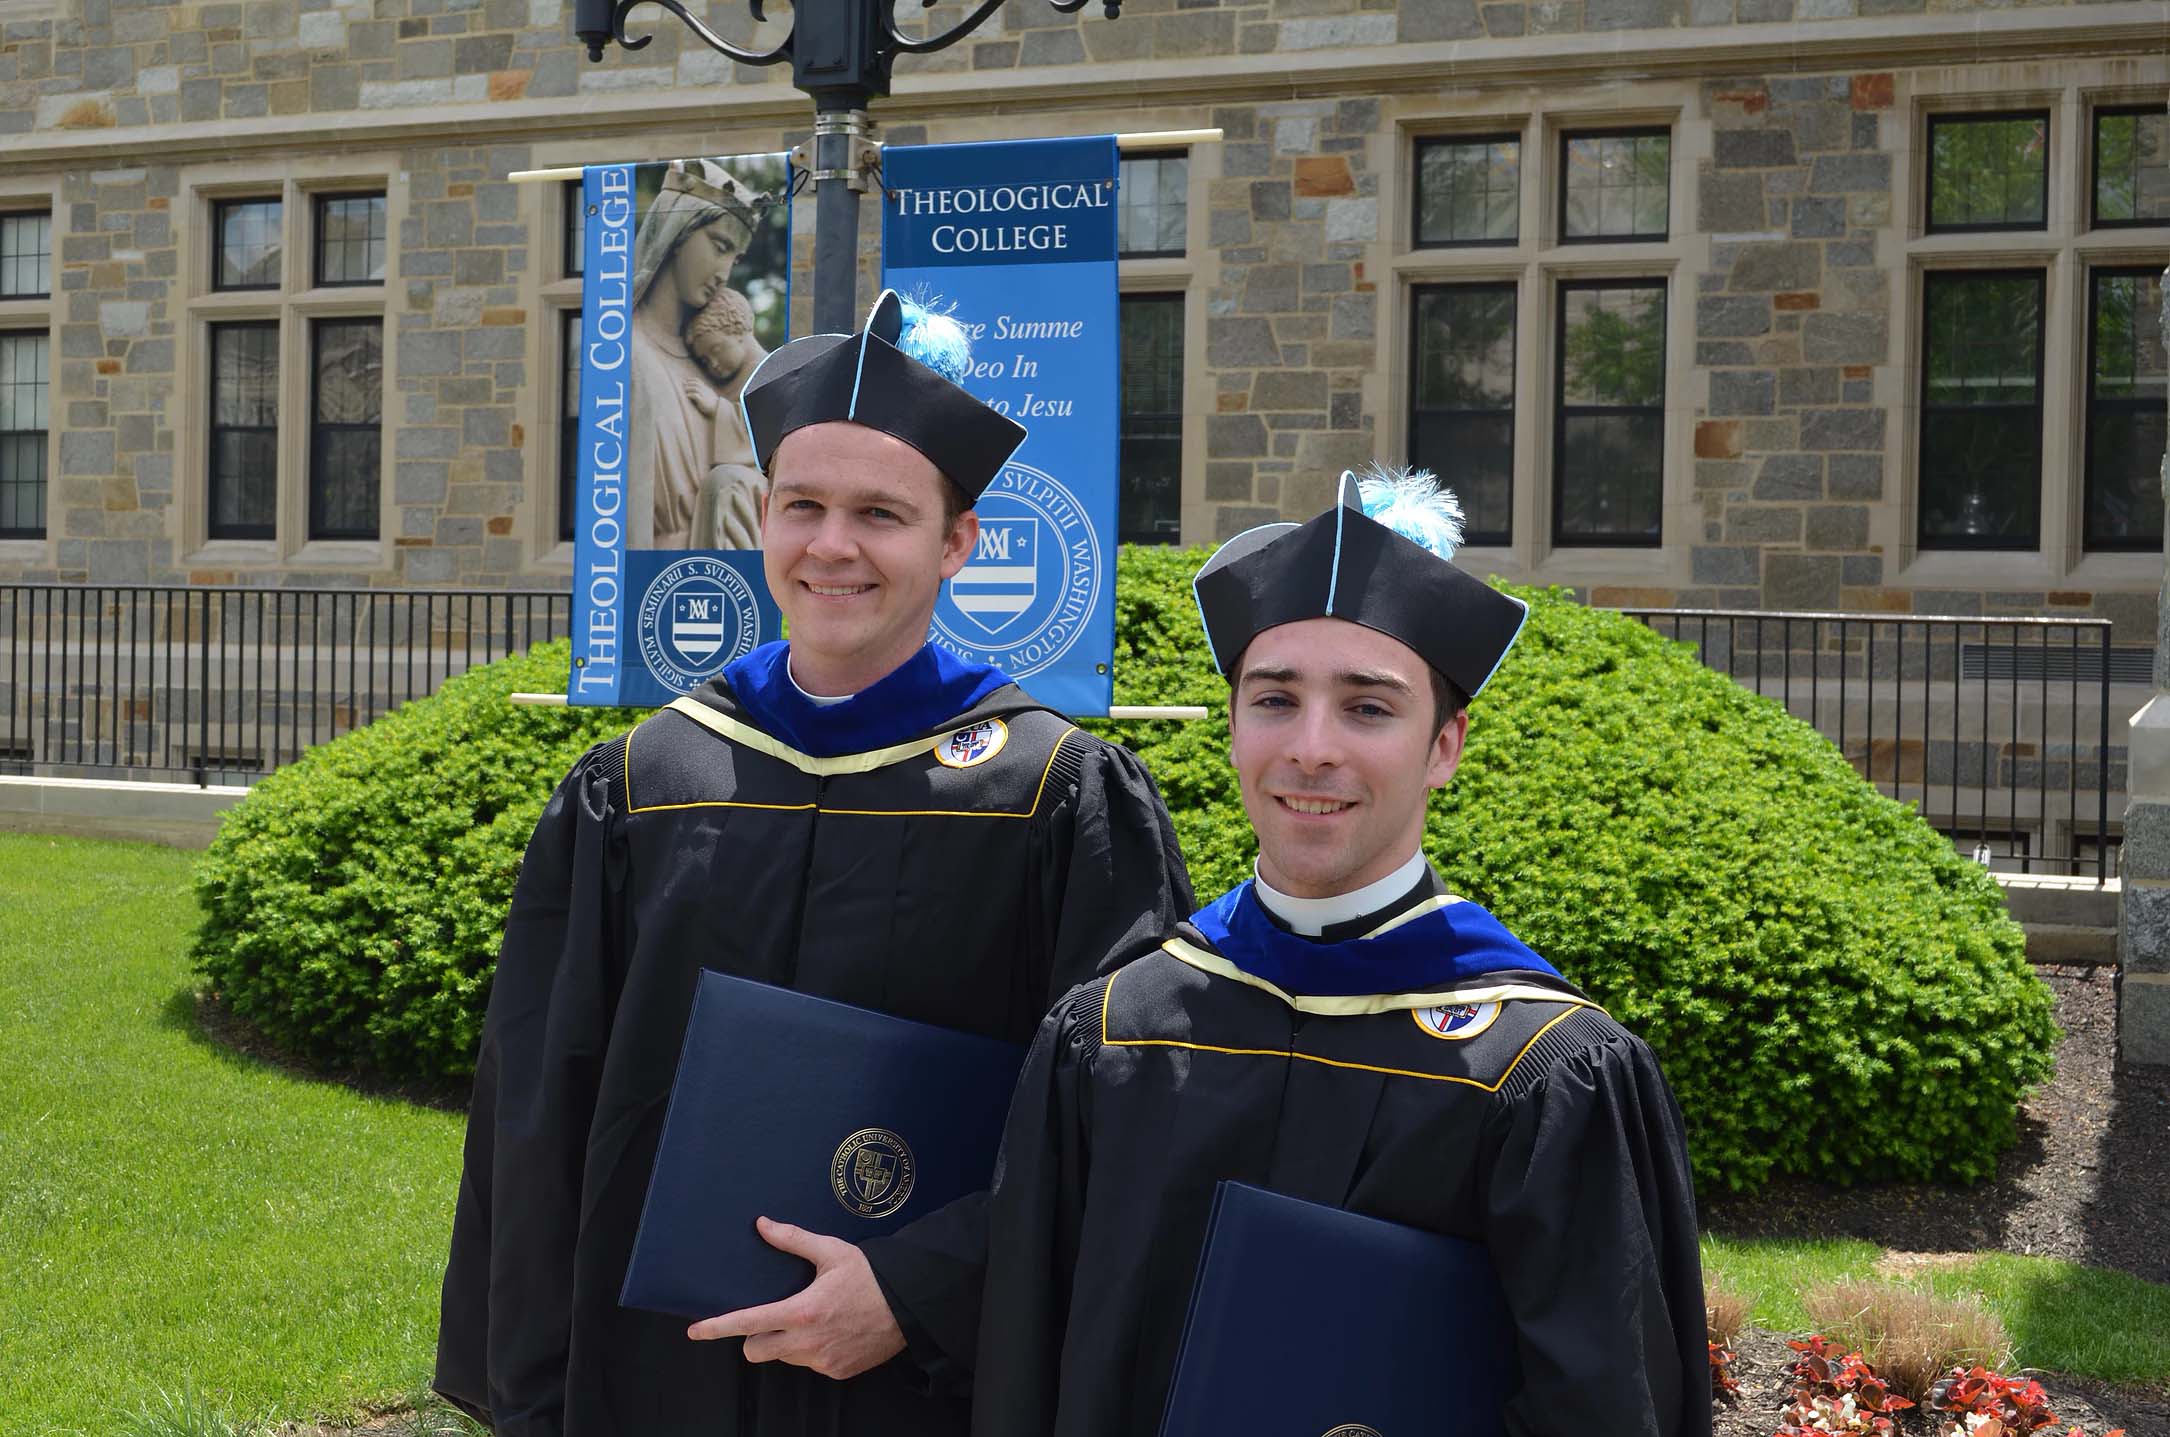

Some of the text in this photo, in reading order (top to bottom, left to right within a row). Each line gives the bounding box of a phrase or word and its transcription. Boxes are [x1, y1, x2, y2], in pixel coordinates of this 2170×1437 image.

[895, 183, 1109, 216] THEOLOGICAL
[931, 225, 1069, 253] COLLEGE
[993, 315, 1084, 340] Summe
[1011, 354, 1038, 378] In
[1016, 393, 1073, 417] Jesu
[577, 167, 631, 694] THEOLOGICAL COLLEGE
[1008, 538, 1092, 670] WASHINGTON
